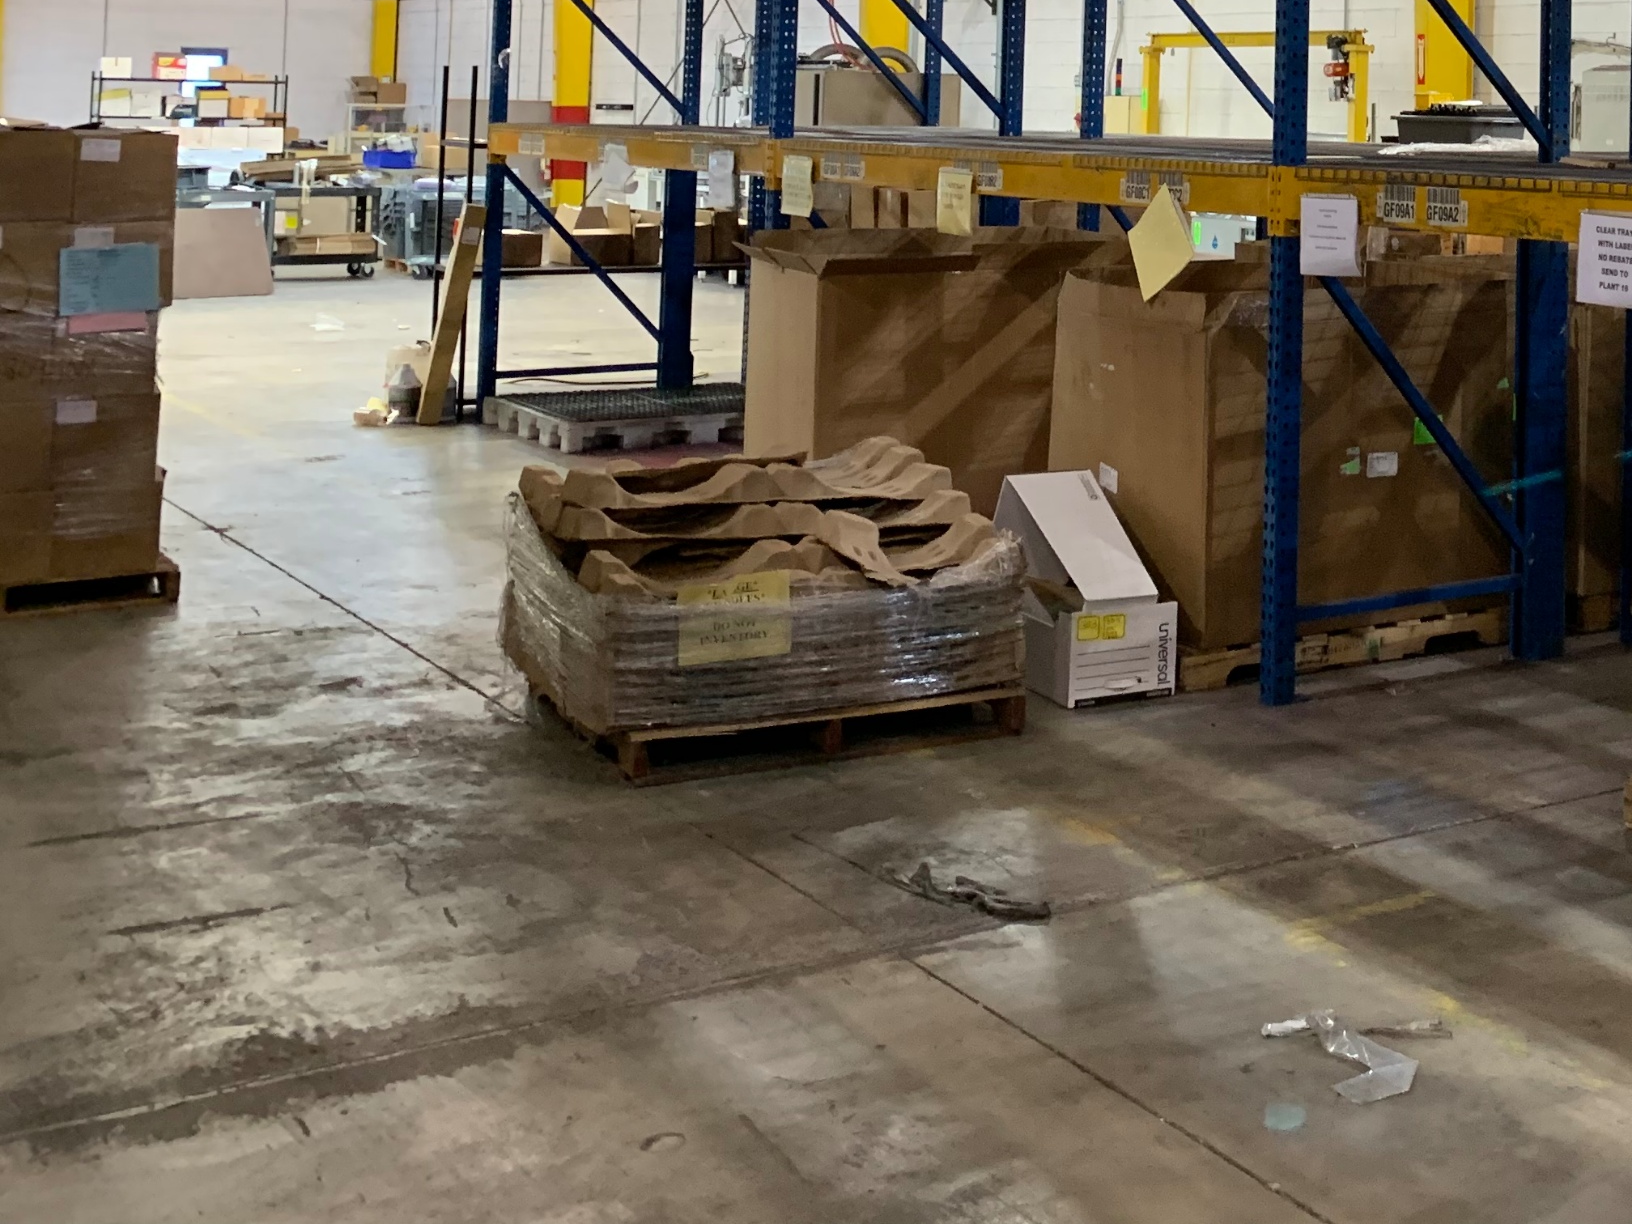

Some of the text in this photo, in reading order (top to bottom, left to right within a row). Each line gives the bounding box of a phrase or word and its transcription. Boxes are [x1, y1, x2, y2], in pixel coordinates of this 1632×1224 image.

[1384, 202, 1459, 223] GF09A1 GF09A2
[1596, 225, 1616, 235] CLEAR
[1598, 239, 1613, 248] WITH
[1598, 254, 1608, 262] NO
[1601, 267, 1629, 278] SEND TO
[1599, 281, 1620, 291] PLANT
[1157, 623, 1172, 686] universal
